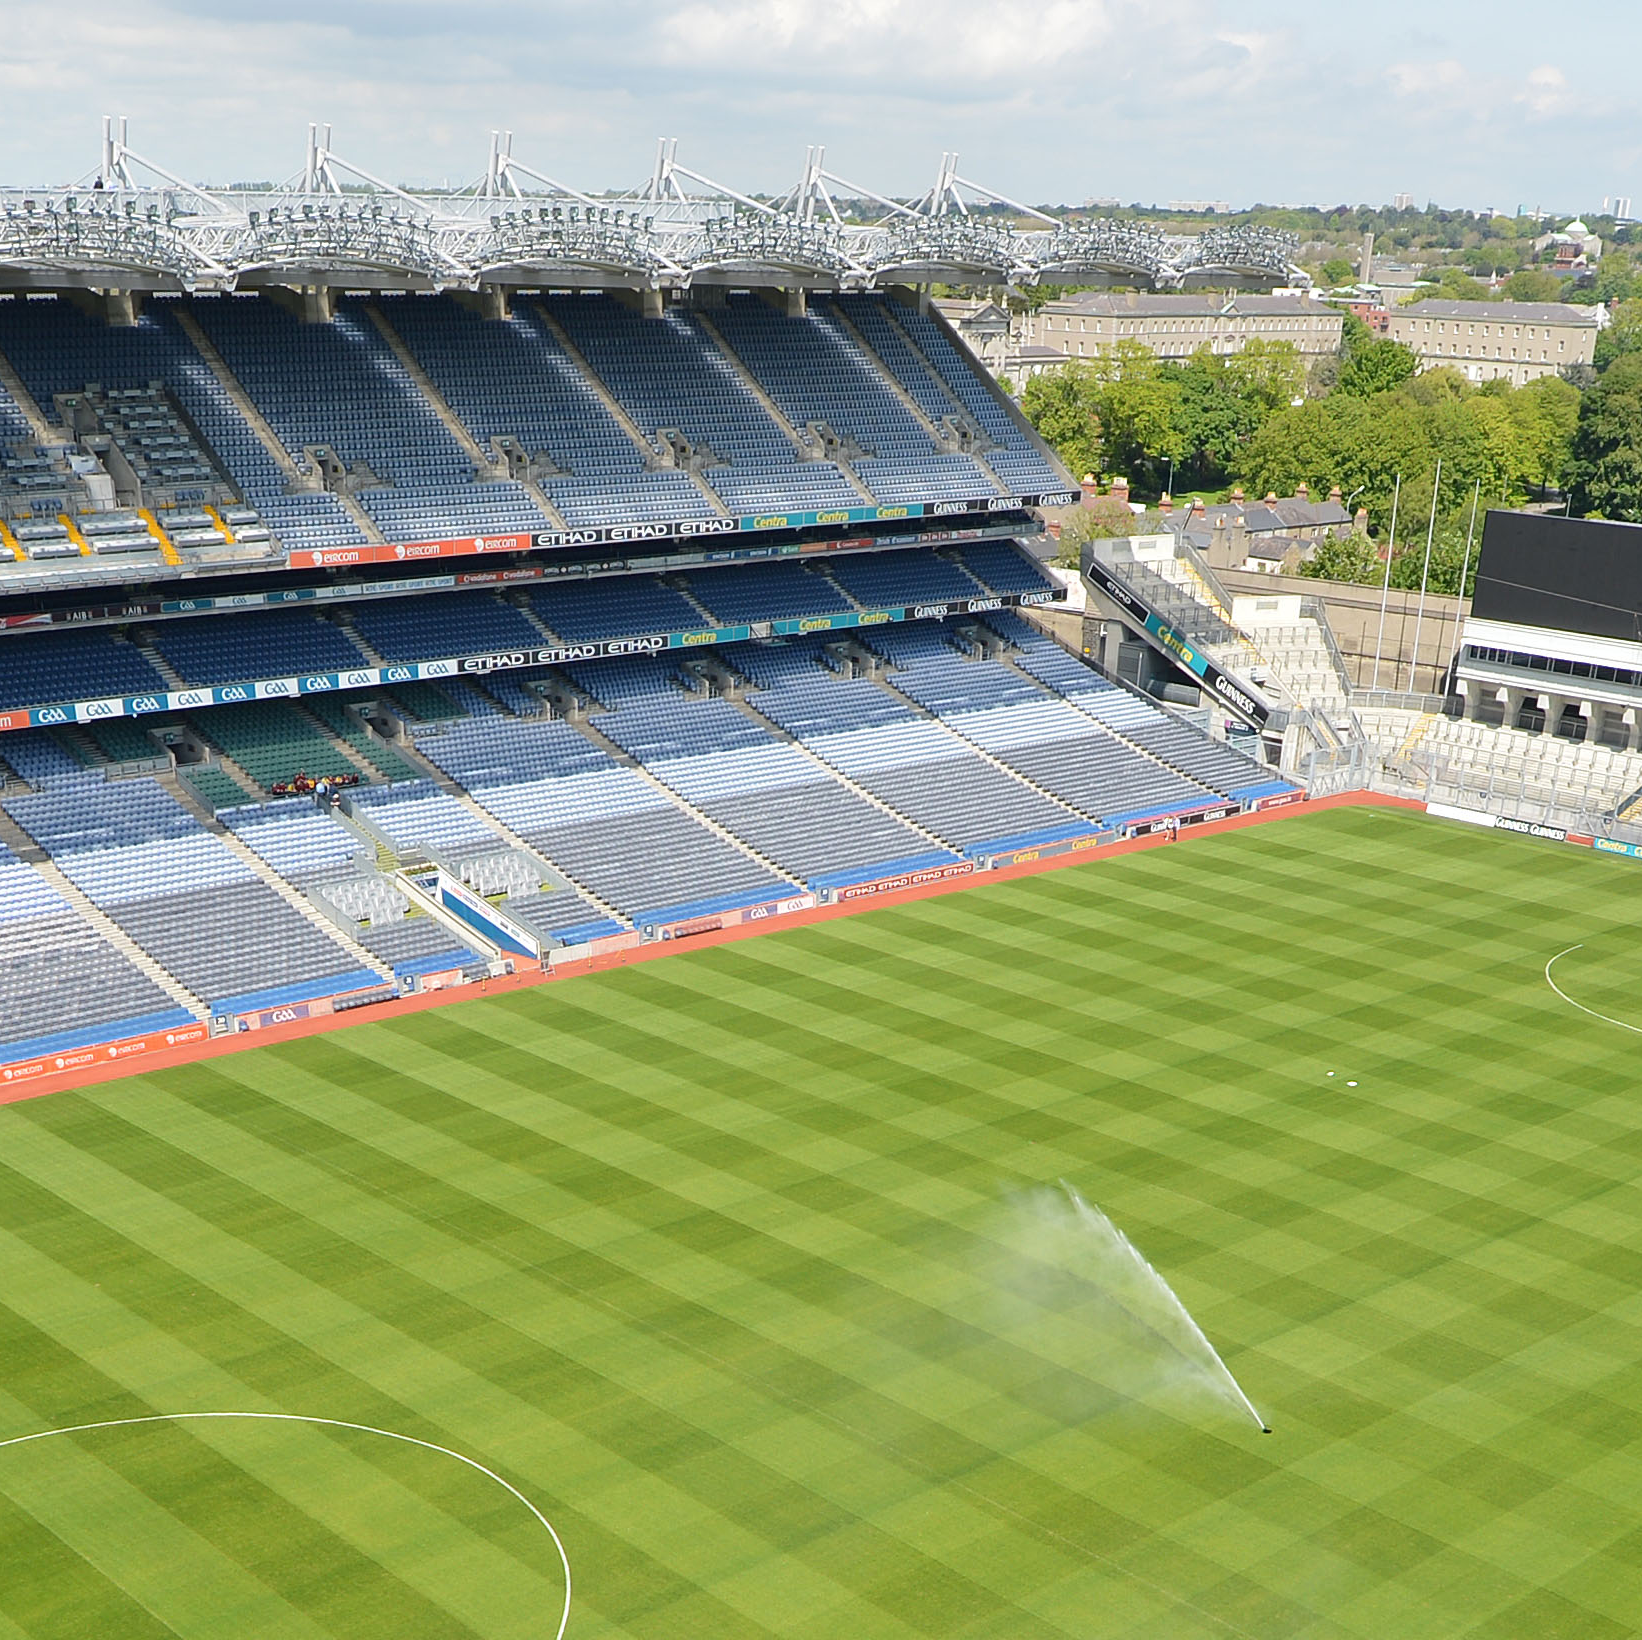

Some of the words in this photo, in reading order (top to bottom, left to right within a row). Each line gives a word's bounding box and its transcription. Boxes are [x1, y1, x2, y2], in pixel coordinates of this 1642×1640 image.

[987, 497, 1023, 510] GUINNESS
[1039, 492, 1072, 505] GUINNESS
[876, 505, 907, 518] Centra
[934, 501, 967, 514] GUINNESS
[754, 516, 787, 528] Centra
[816, 509, 849, 523] Centra
[610, 525, 667, 540] ETIHAD
[679, 518, 734, 533] ETIHAD
[537, 530, 596, 547] ETIHAD
[967, 598, 1002, 612] GUINNESS
[1020, 592, 1053, 606] GUINNESS
[858, 611, 890, 625] Centra
[914, 604, 948, 618] GUINNESS
[799, 617, 831, 631] Centra
[681, 631, 717, 644] Centra
[1157, 625, 1194, 662] Centra
[608, 638, 663, 653] ETIHAD
[537, 646, 595, 662] ETIHAD
[427, 662, 449, 675] GAA
[464, 654, 524, 671] ETIHAD
[348, 672, 372, 685] GAA
[388, 667, 412, 680] GAA
[264, 682, 289, 695] GAA
[307, 677, 332, 691] GAA
[177, 691, 204, 706] GAA
[221, 686, 248, 701] GAA
[1215, 675, 1256, 715] GUINNESS
[86, 701, 113, 717] GAA
[132, 696, 160, 711] GAA
[38, 707, 67, 723] GAA
[1496, 817, 1528, 833] GUINNESS
[1530, 824, 1565, 841] GUINNESS
[1072, 838, 1097, 850] Centra
[1597, 838, 1627, 853] Centra
[1013, 851, 1039, 863] Centra
[943, 864, 973, 876] ETIHAD
[913, 871, 942, 884] ETIHAD
[845, 886, 876, 898] ETIHAD
[878, 879, 908, 891] ETIHAD
[787, 899, 804, 911] GAA
[750, 907, 769, 920] GAA
[272, 1008, 297, 1024] GAA
